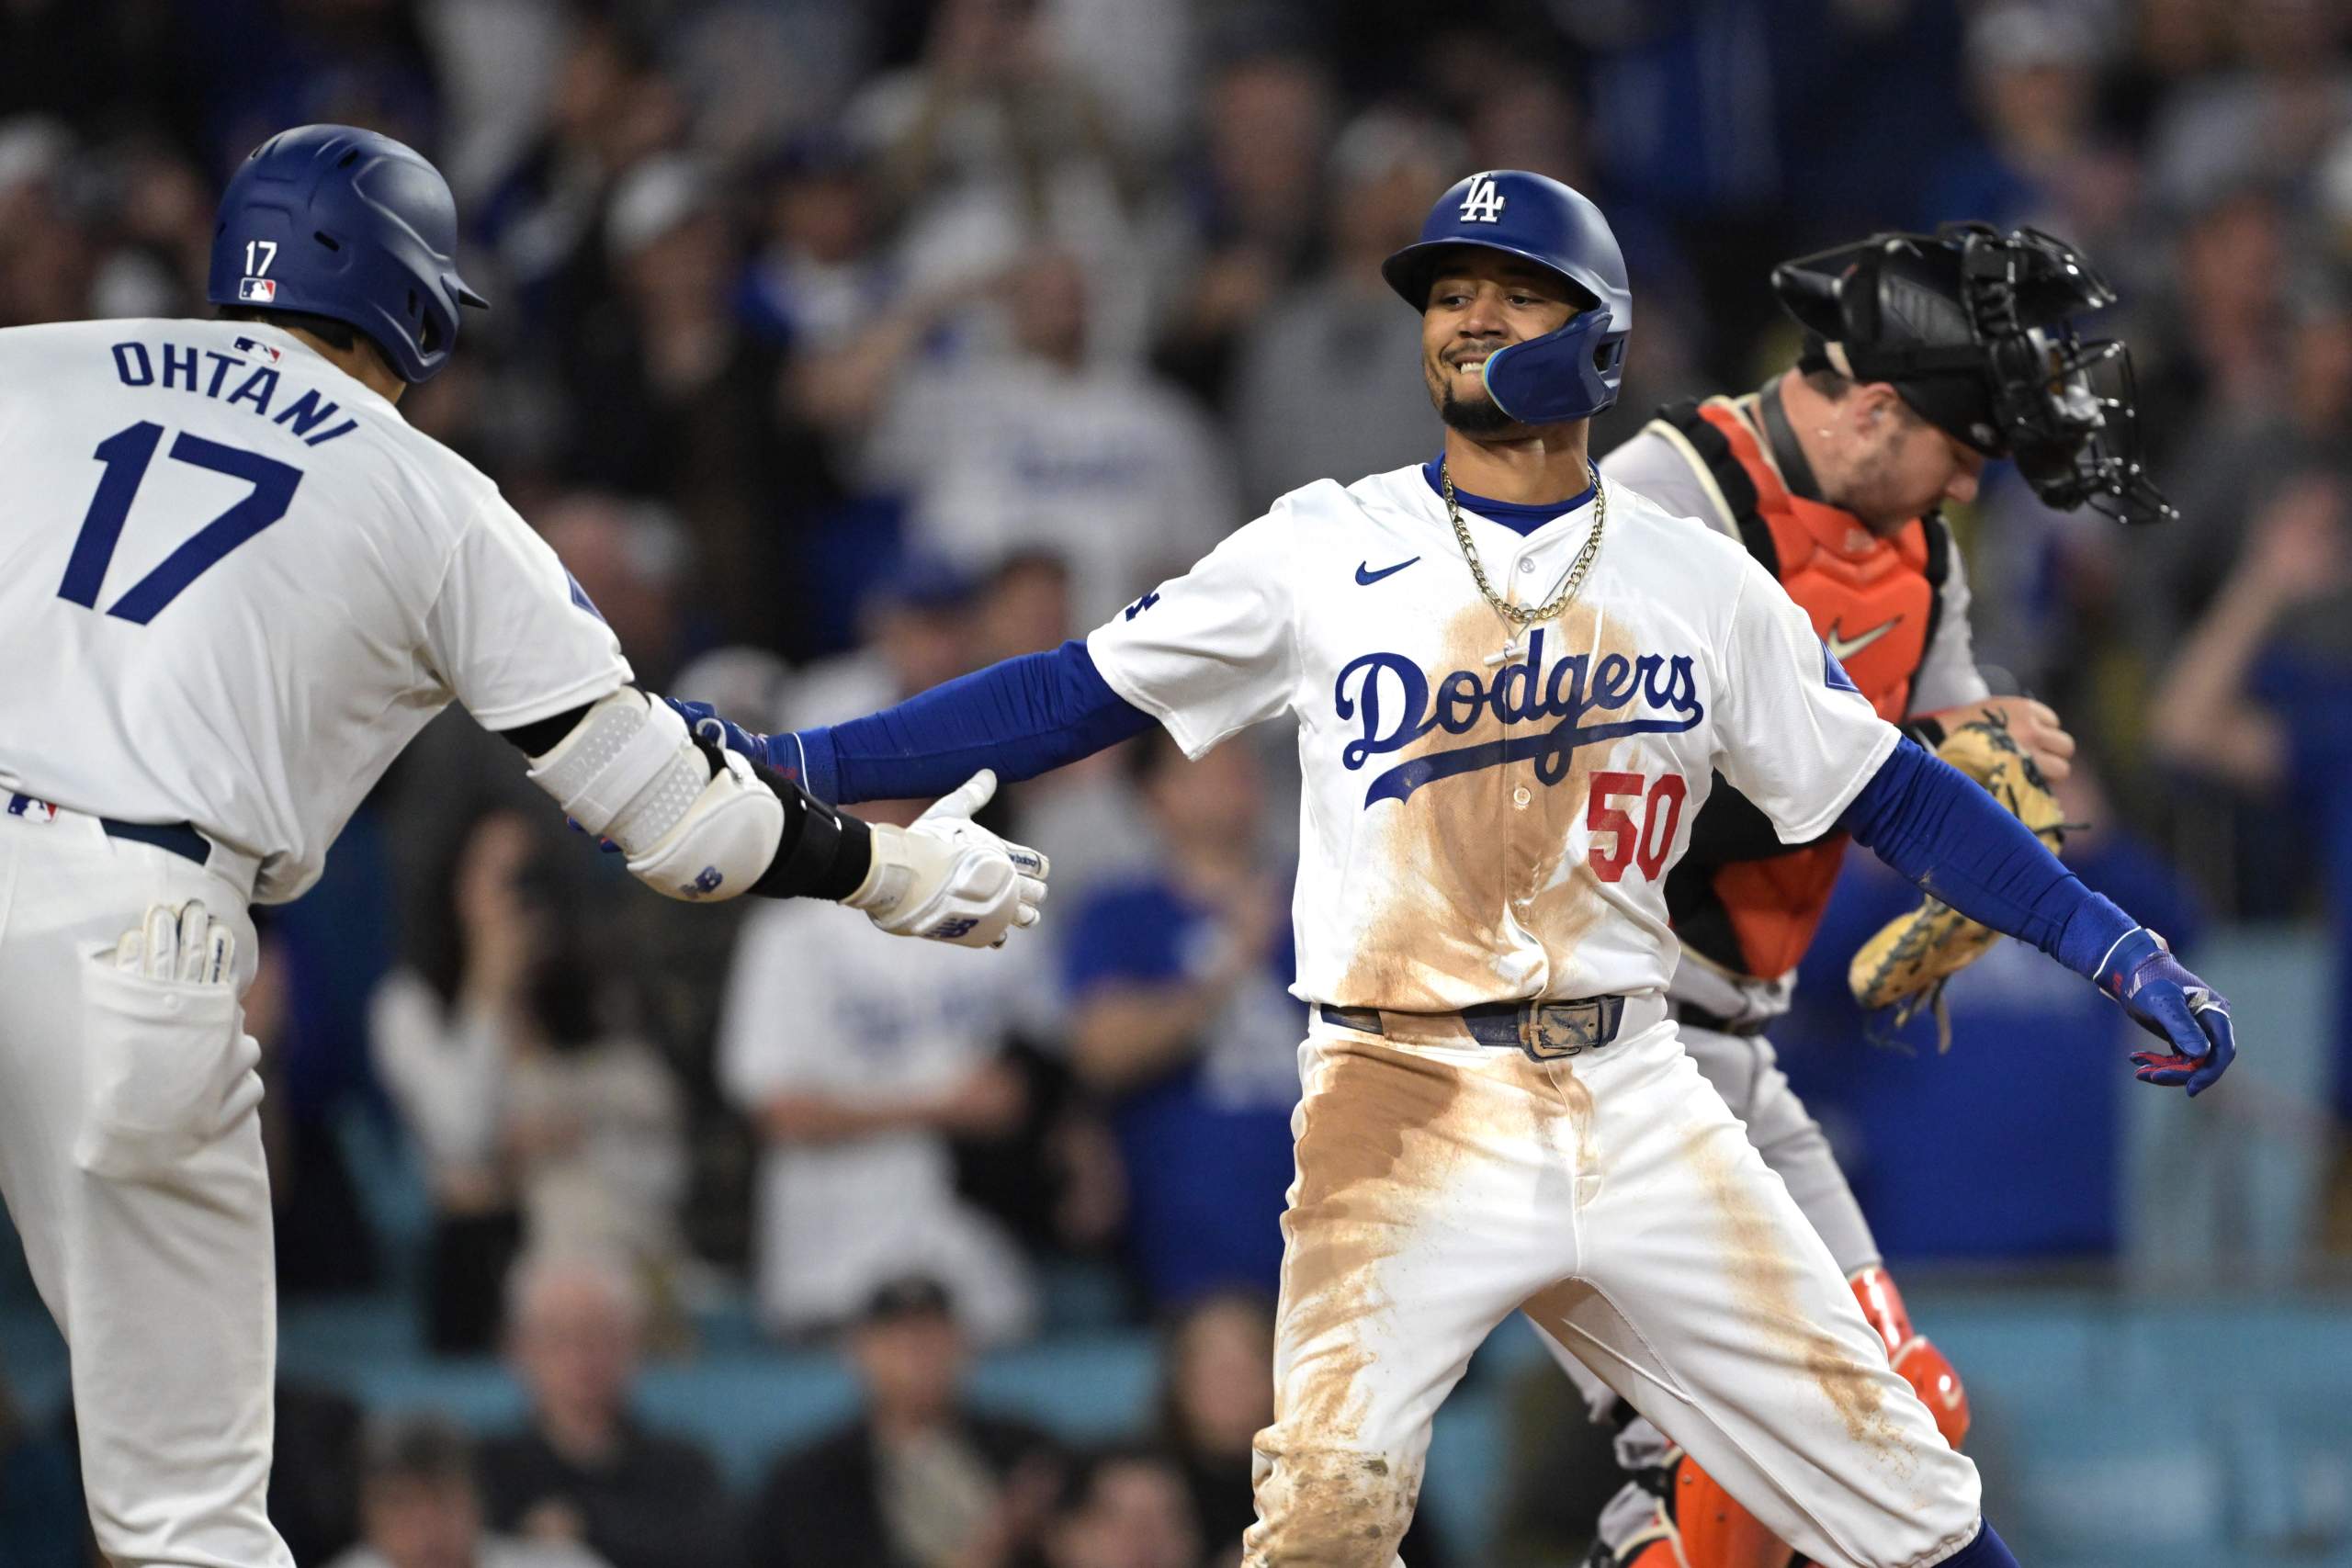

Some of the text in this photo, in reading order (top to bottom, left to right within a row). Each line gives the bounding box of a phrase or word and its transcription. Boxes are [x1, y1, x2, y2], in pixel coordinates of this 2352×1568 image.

[245, 240, 277, 276] 17
[111, 341, 358, 446] OHTANI
[57, 420, 304, 626] 17
[1335, 628, 1704, 787] Dodgers
[1586, 771, 1687, 883] 50
